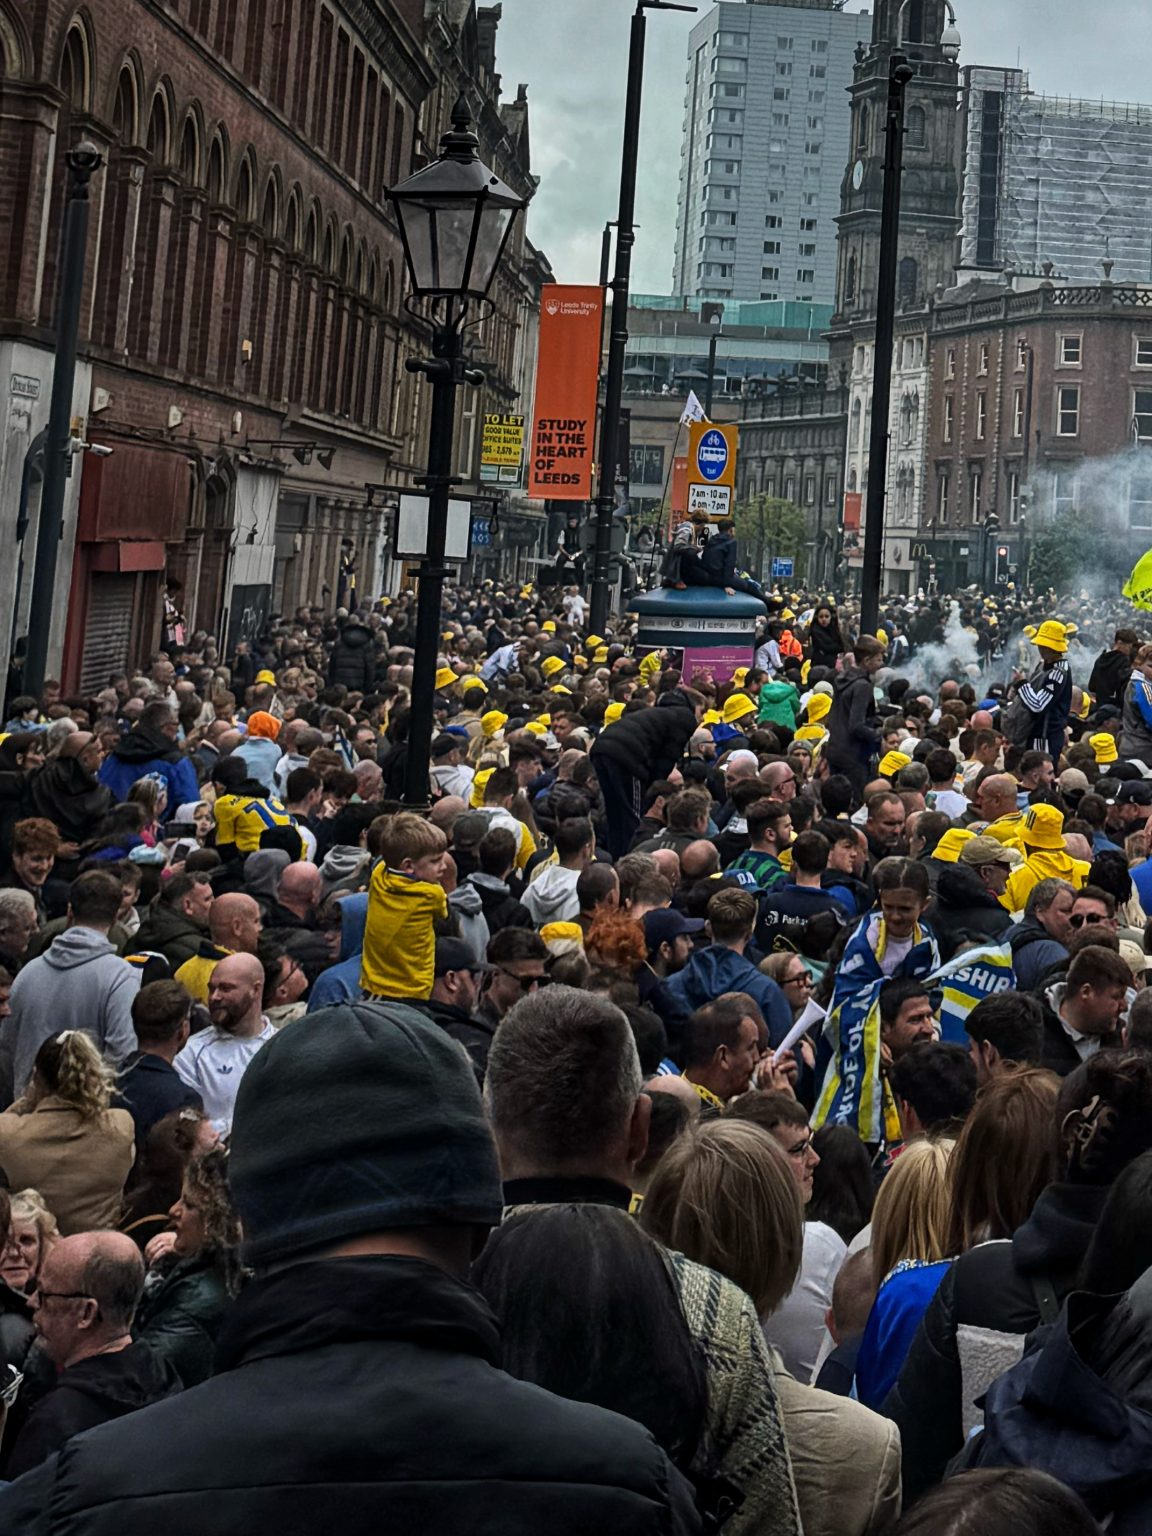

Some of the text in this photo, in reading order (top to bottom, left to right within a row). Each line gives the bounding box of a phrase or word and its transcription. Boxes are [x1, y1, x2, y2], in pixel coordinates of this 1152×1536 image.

[560, 308, 590, 316] University
[485, 414, 524, 425] TO LET
[537, 419, 588, 432] STUDY
[485, 426, 502, 434] GOOD
[536, 432, 586, 445] IN THE
[535, 445, 588, 458] HEART
[534, 459, 555, 470] OF
[534, 472, 581, 485] LEEDS
[942, 966, 1012, 994] SHIP
